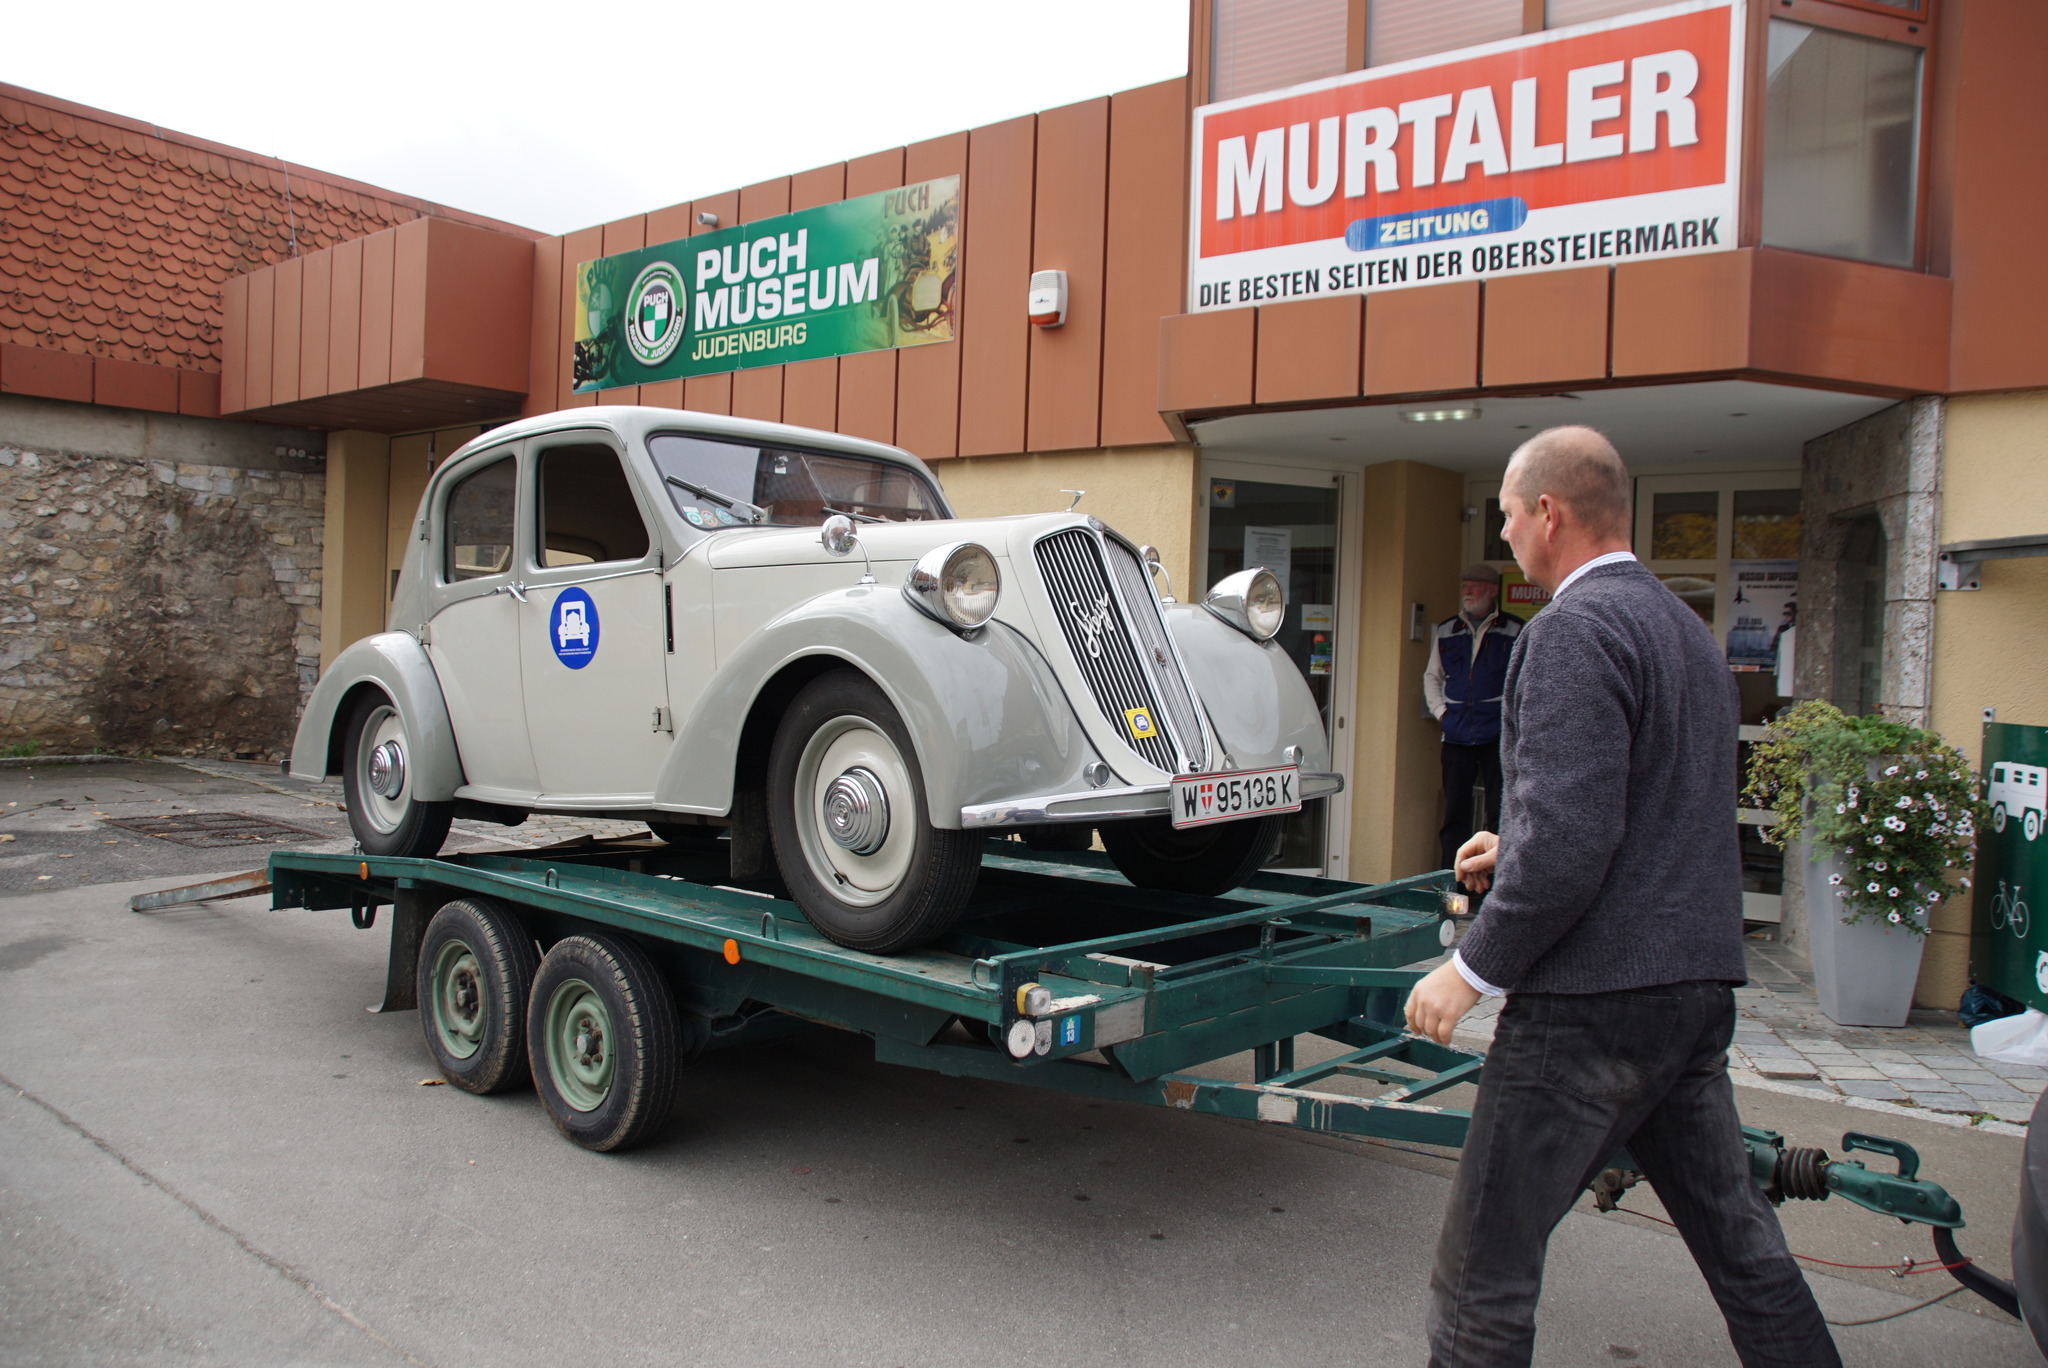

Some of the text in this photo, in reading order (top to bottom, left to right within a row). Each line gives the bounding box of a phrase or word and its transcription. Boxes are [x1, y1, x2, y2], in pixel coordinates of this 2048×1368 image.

[1215, 48, 1700, 221] MURTALER
[884, 183, 930, 219] PUCH
[1379, 208, 1489, 244] ZEITUNG
[695, 228, 808, 291] PUCH
[1199, 216, 1721, 307] DIE BESTEN SEITEN DER OBERSTEIERMARK
[644, 292, 668, 307] PUCH
[694, 257, 880, 333] MUSEUM
[628, 315, 682, 358] MUSEUM JUDENBURG
[692, 321, 808, 362] JUDENBURG
[1070, 591, 1114, 658] Steyr
[1182, 773, 1293, 817] W 95136 K
